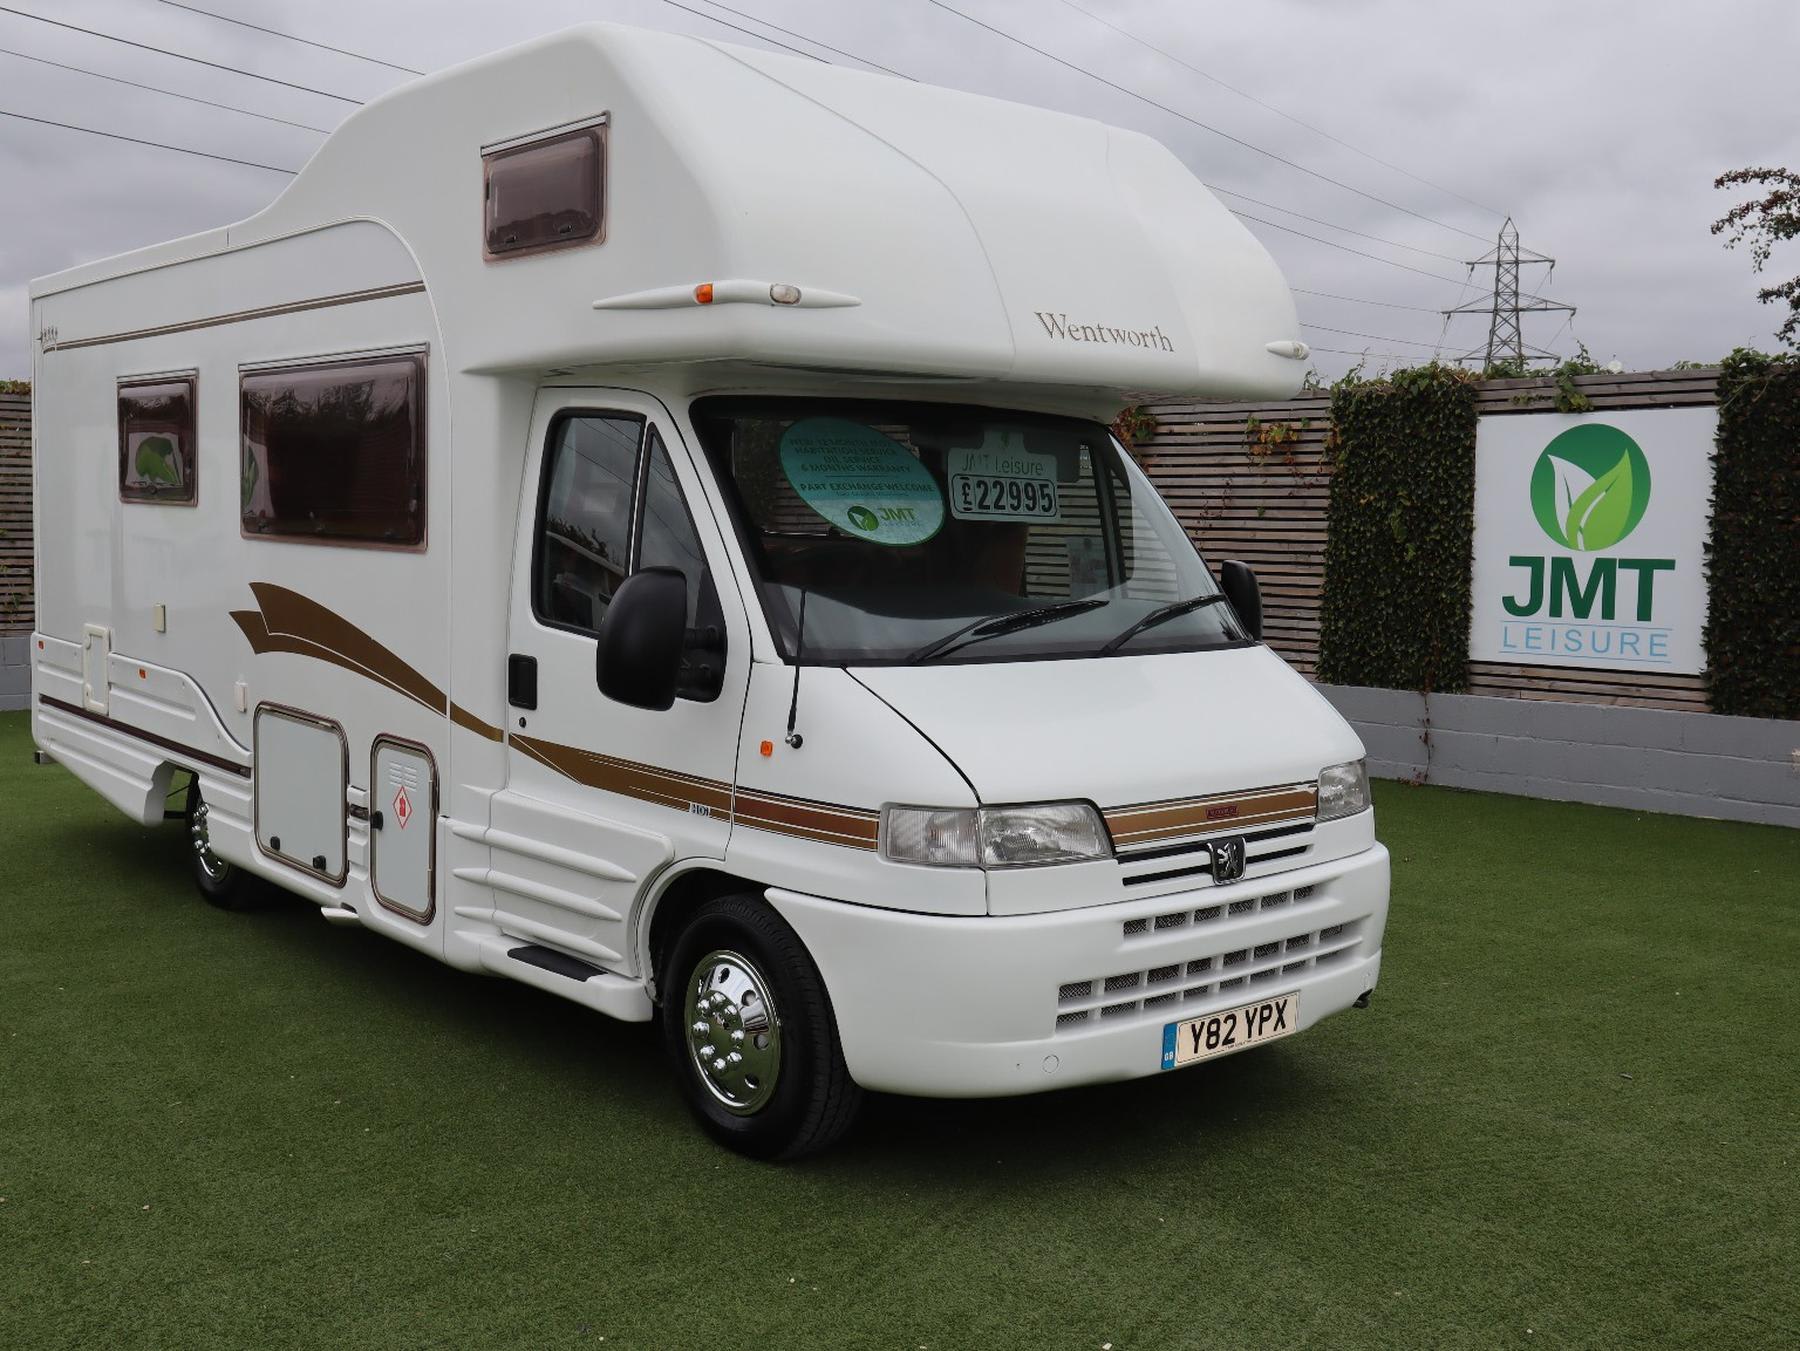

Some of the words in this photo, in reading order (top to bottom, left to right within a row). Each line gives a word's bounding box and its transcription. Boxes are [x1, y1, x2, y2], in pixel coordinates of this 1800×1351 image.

[1034, 312, 1174, 352] Wentworth
[995, 455, 1044, 476] Leisure
[800, 483, 827, 492] PART
[830, 483, 884, 492] EXCHANGE
[885, 484, 937, 493] WELCOME
[878, 507, 917, 522] JMT
[1502, 556, 1676, 622] JMT
[1503, 626, 1668, 657] LEISURE
[1191, 1013, 1237, 1054] Y82
[1245, 999, 1288, 1039] YPX
[1164, 1051, 1174, 1061] GB
